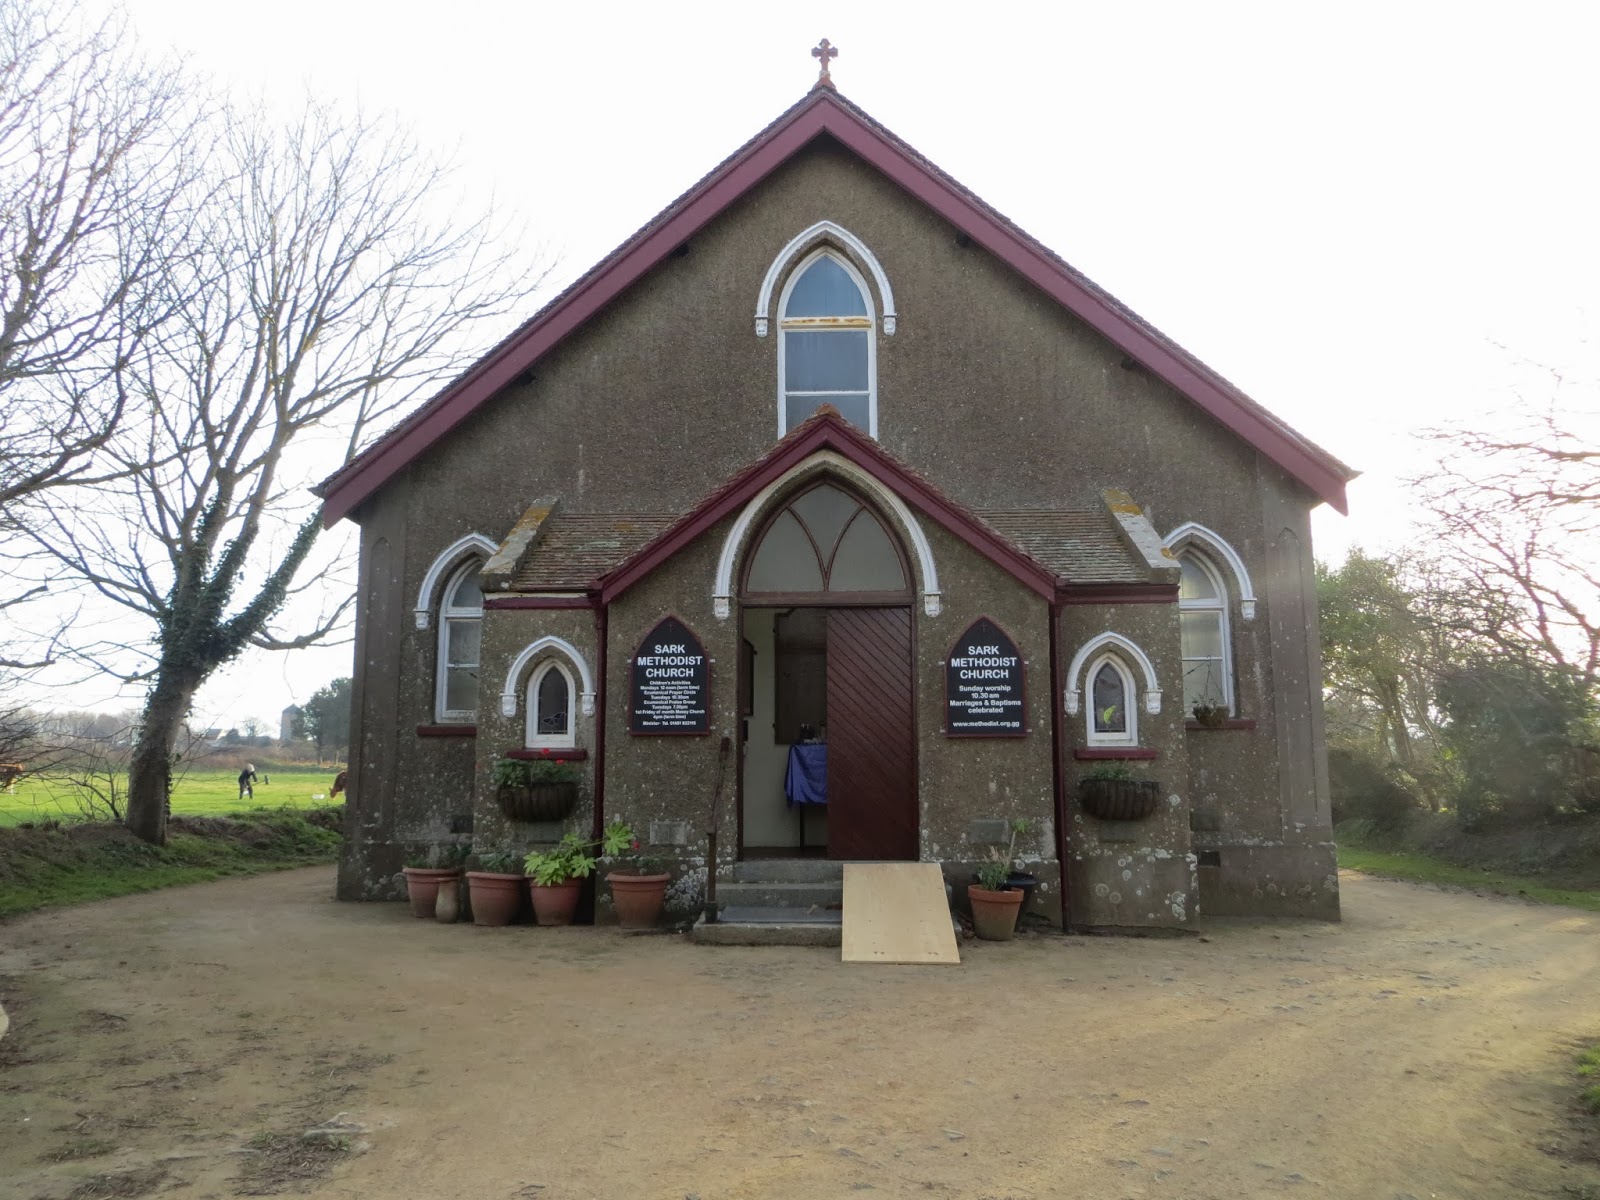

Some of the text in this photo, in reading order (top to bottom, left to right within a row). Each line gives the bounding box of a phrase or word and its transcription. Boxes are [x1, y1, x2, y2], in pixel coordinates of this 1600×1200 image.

[655, 645, 685, 653] SARK
[968, 646, 999, 654] SARK
[638, 656, 702, 665] METHODIST
[951, 657, 1017, 667] METHODIST
[646, 668, 694, 677] CHURCH
[960, 670, 1008, 678] CHURCH
